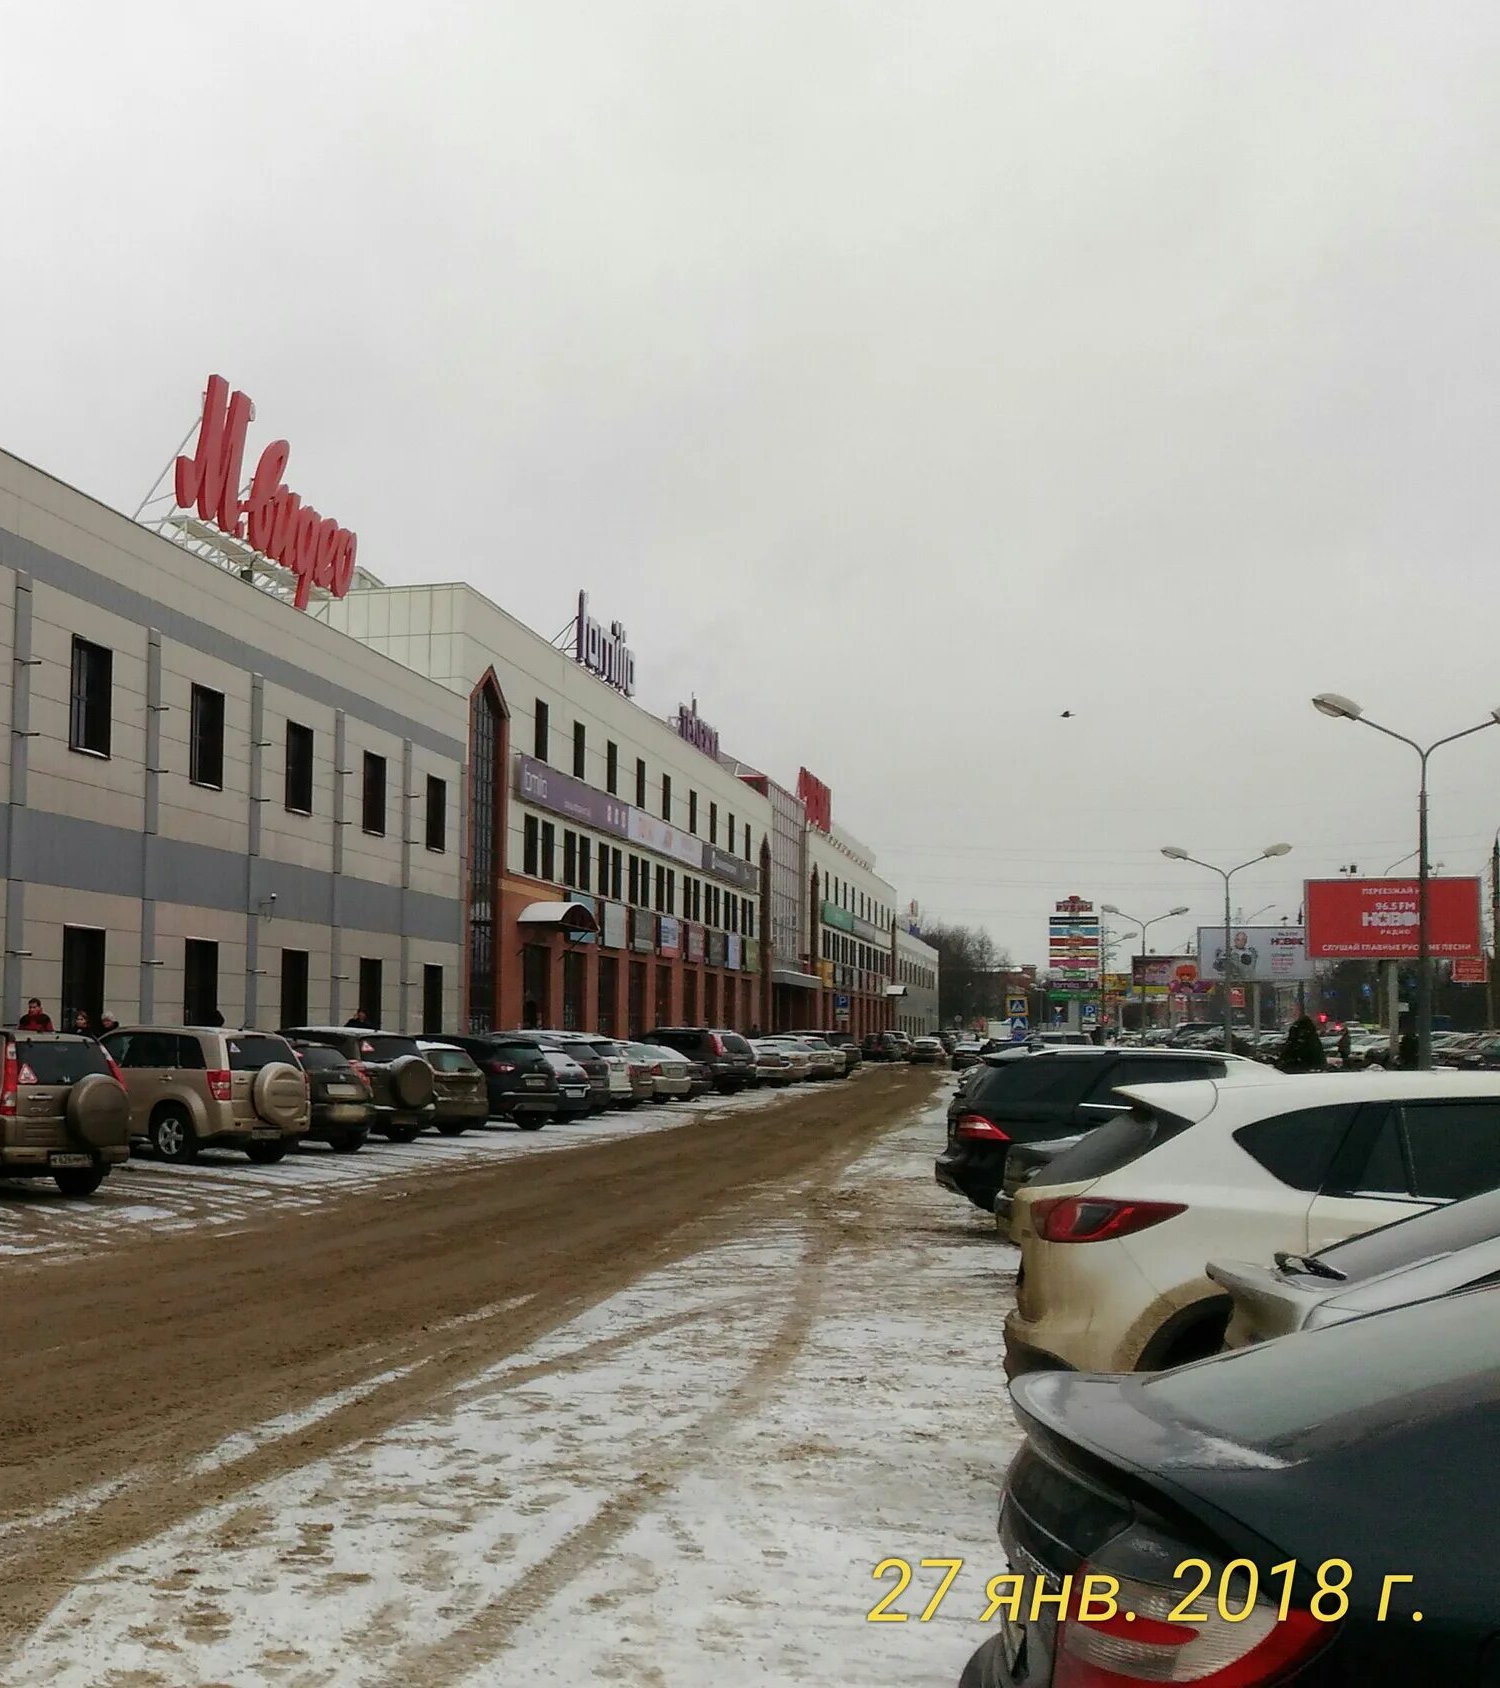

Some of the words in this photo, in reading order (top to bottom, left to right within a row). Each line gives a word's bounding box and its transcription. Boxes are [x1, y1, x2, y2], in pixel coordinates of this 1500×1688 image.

[1361, 886, 1414, 896] ПЕРЕЕЗЖАЙ
[1375, 902, 1398, 911] 96.5
[1399, 902, 1416, 911] FM
[1322, 942, 1360, 952] СЛУШАЙ
[1361, 943, 1401, 951] ГЛАВНЫЕ
[1401, 943, 1440, 951] РУСИЕ
[1442, 943, 1472, 951] ПЕСНИ
